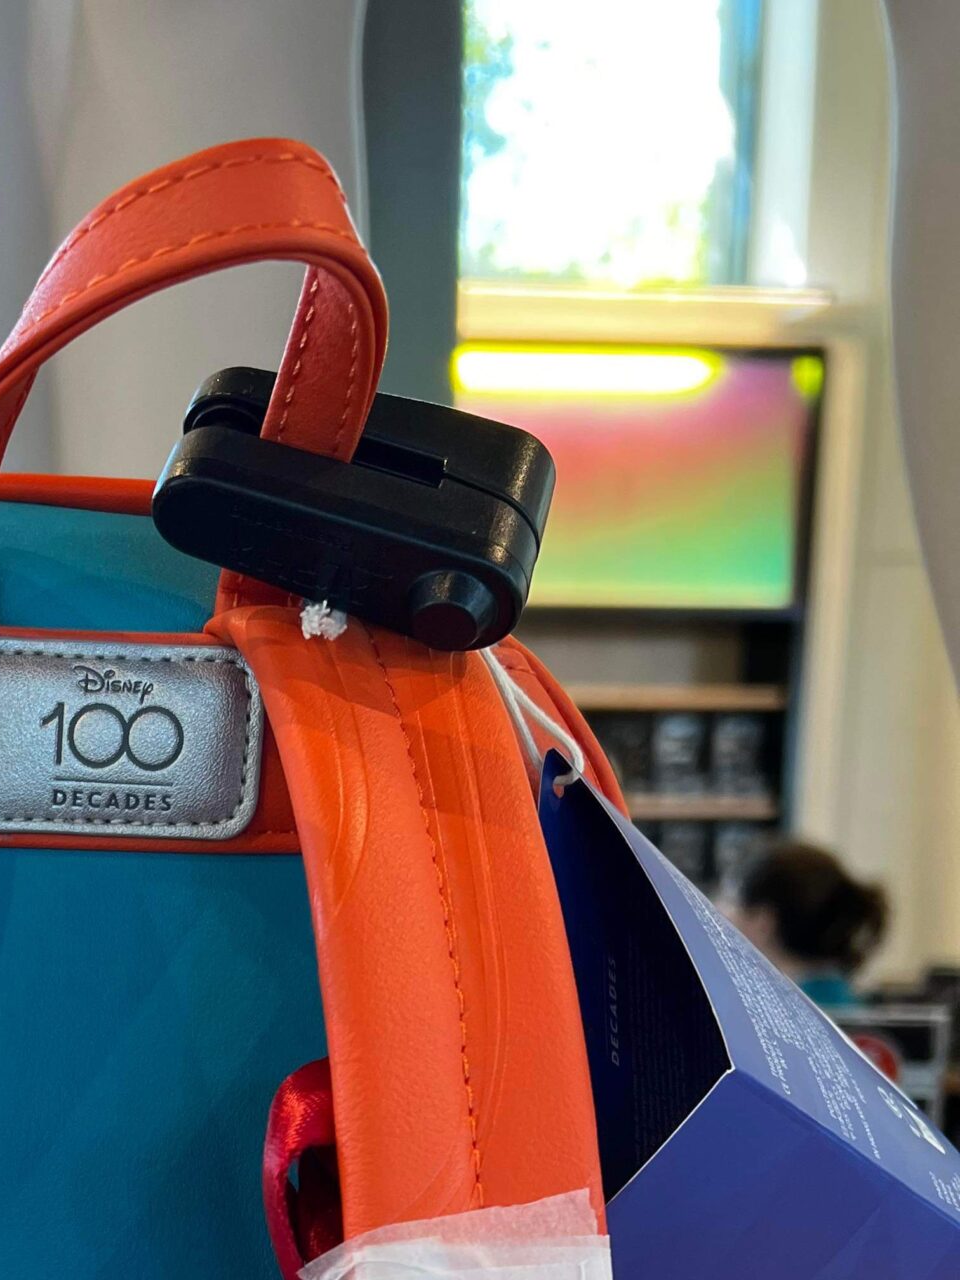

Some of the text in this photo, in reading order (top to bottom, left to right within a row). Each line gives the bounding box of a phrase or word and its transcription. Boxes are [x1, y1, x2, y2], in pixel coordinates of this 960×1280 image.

[73, 665, 154, 705] Disney
[41, 701, 185, 771] 100
[51, 788, 173, 812] DECADES
[608, 957, 620, 1068] DECADES
